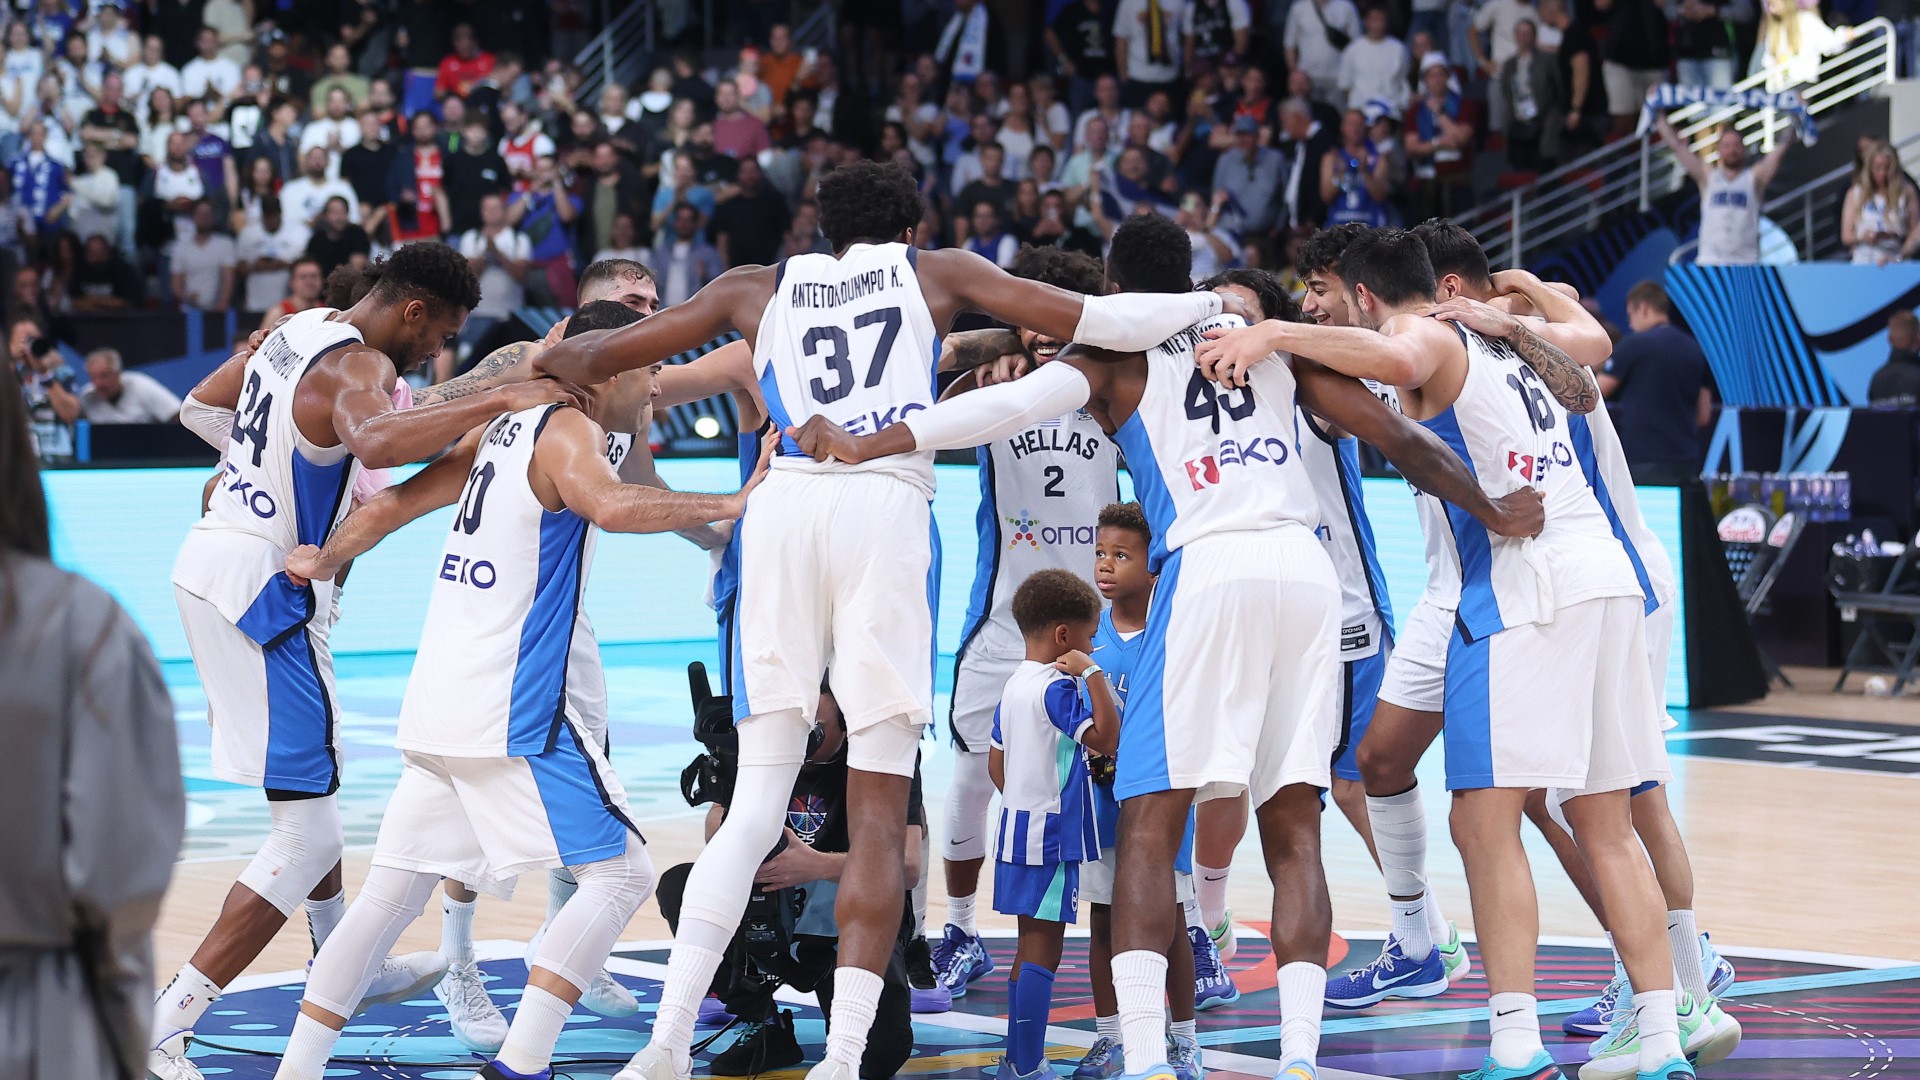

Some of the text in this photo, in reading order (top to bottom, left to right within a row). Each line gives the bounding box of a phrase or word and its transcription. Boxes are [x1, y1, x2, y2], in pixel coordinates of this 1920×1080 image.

[792, 264, 903, 308] ANTETOKOUNMPO K.
[802, 306, 902, 405] 37
[1506, 364, 1556, 435] 16
[1008, 428, 1100, 460] HELLAS
[1220, 437, 1288, 465] EKO
[453, 461, 496, 535] 10
[1043, 465, 1065, 497] 2
[440, 553, 497, 589] EKO
